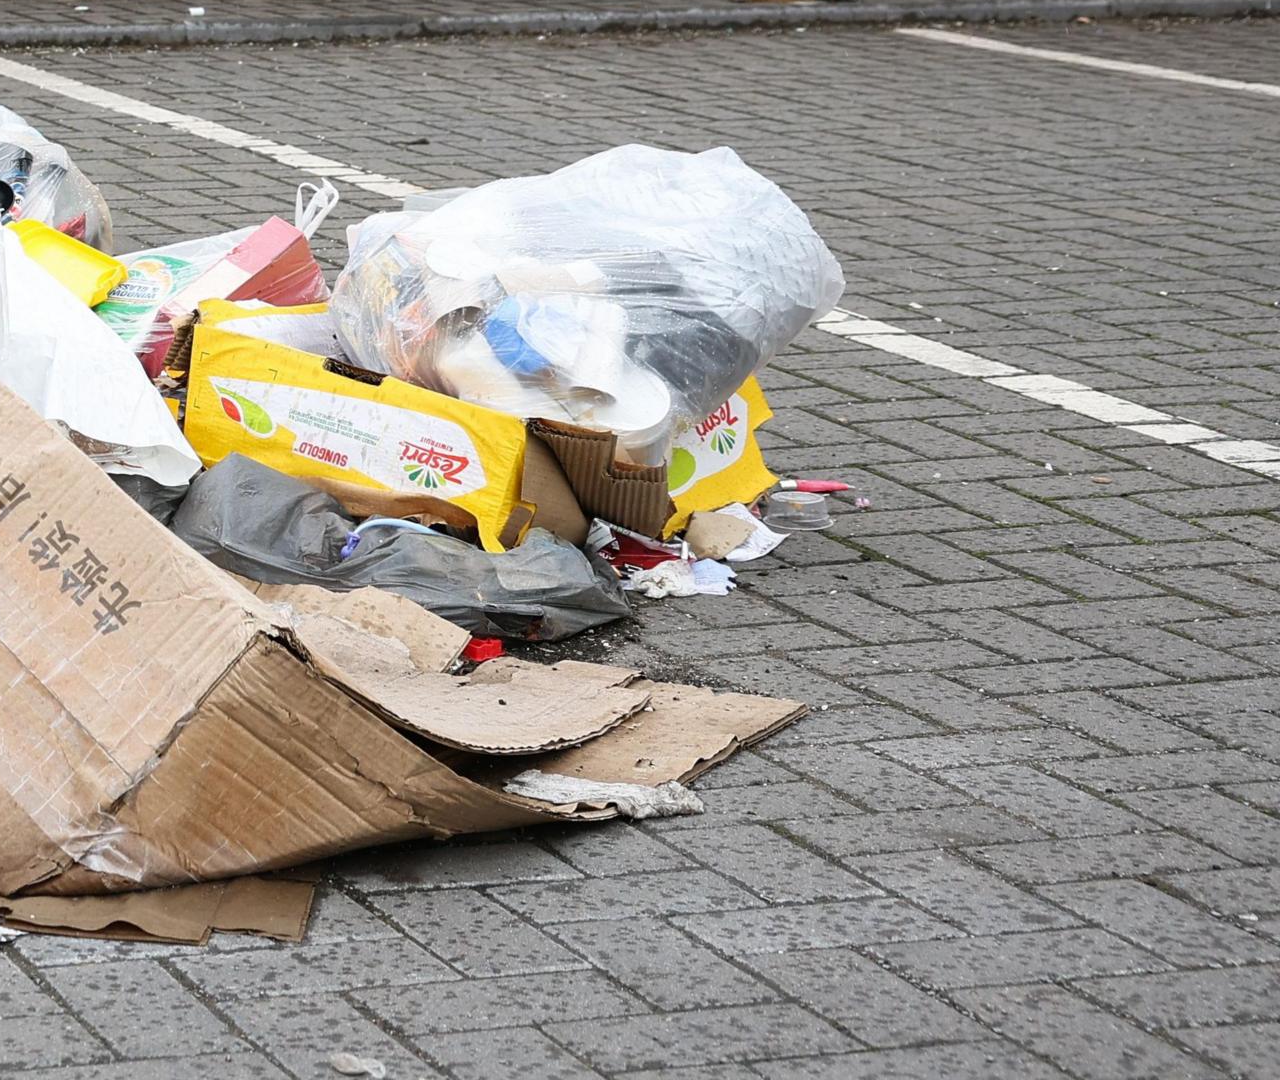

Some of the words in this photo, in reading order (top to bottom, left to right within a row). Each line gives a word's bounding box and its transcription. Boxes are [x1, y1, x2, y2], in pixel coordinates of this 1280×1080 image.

[299, 441, 349, 468] SUNGOLD
[420, 436, 454, 452] KIWIFRUIT
[400, 441, 470, 485] Zespri
